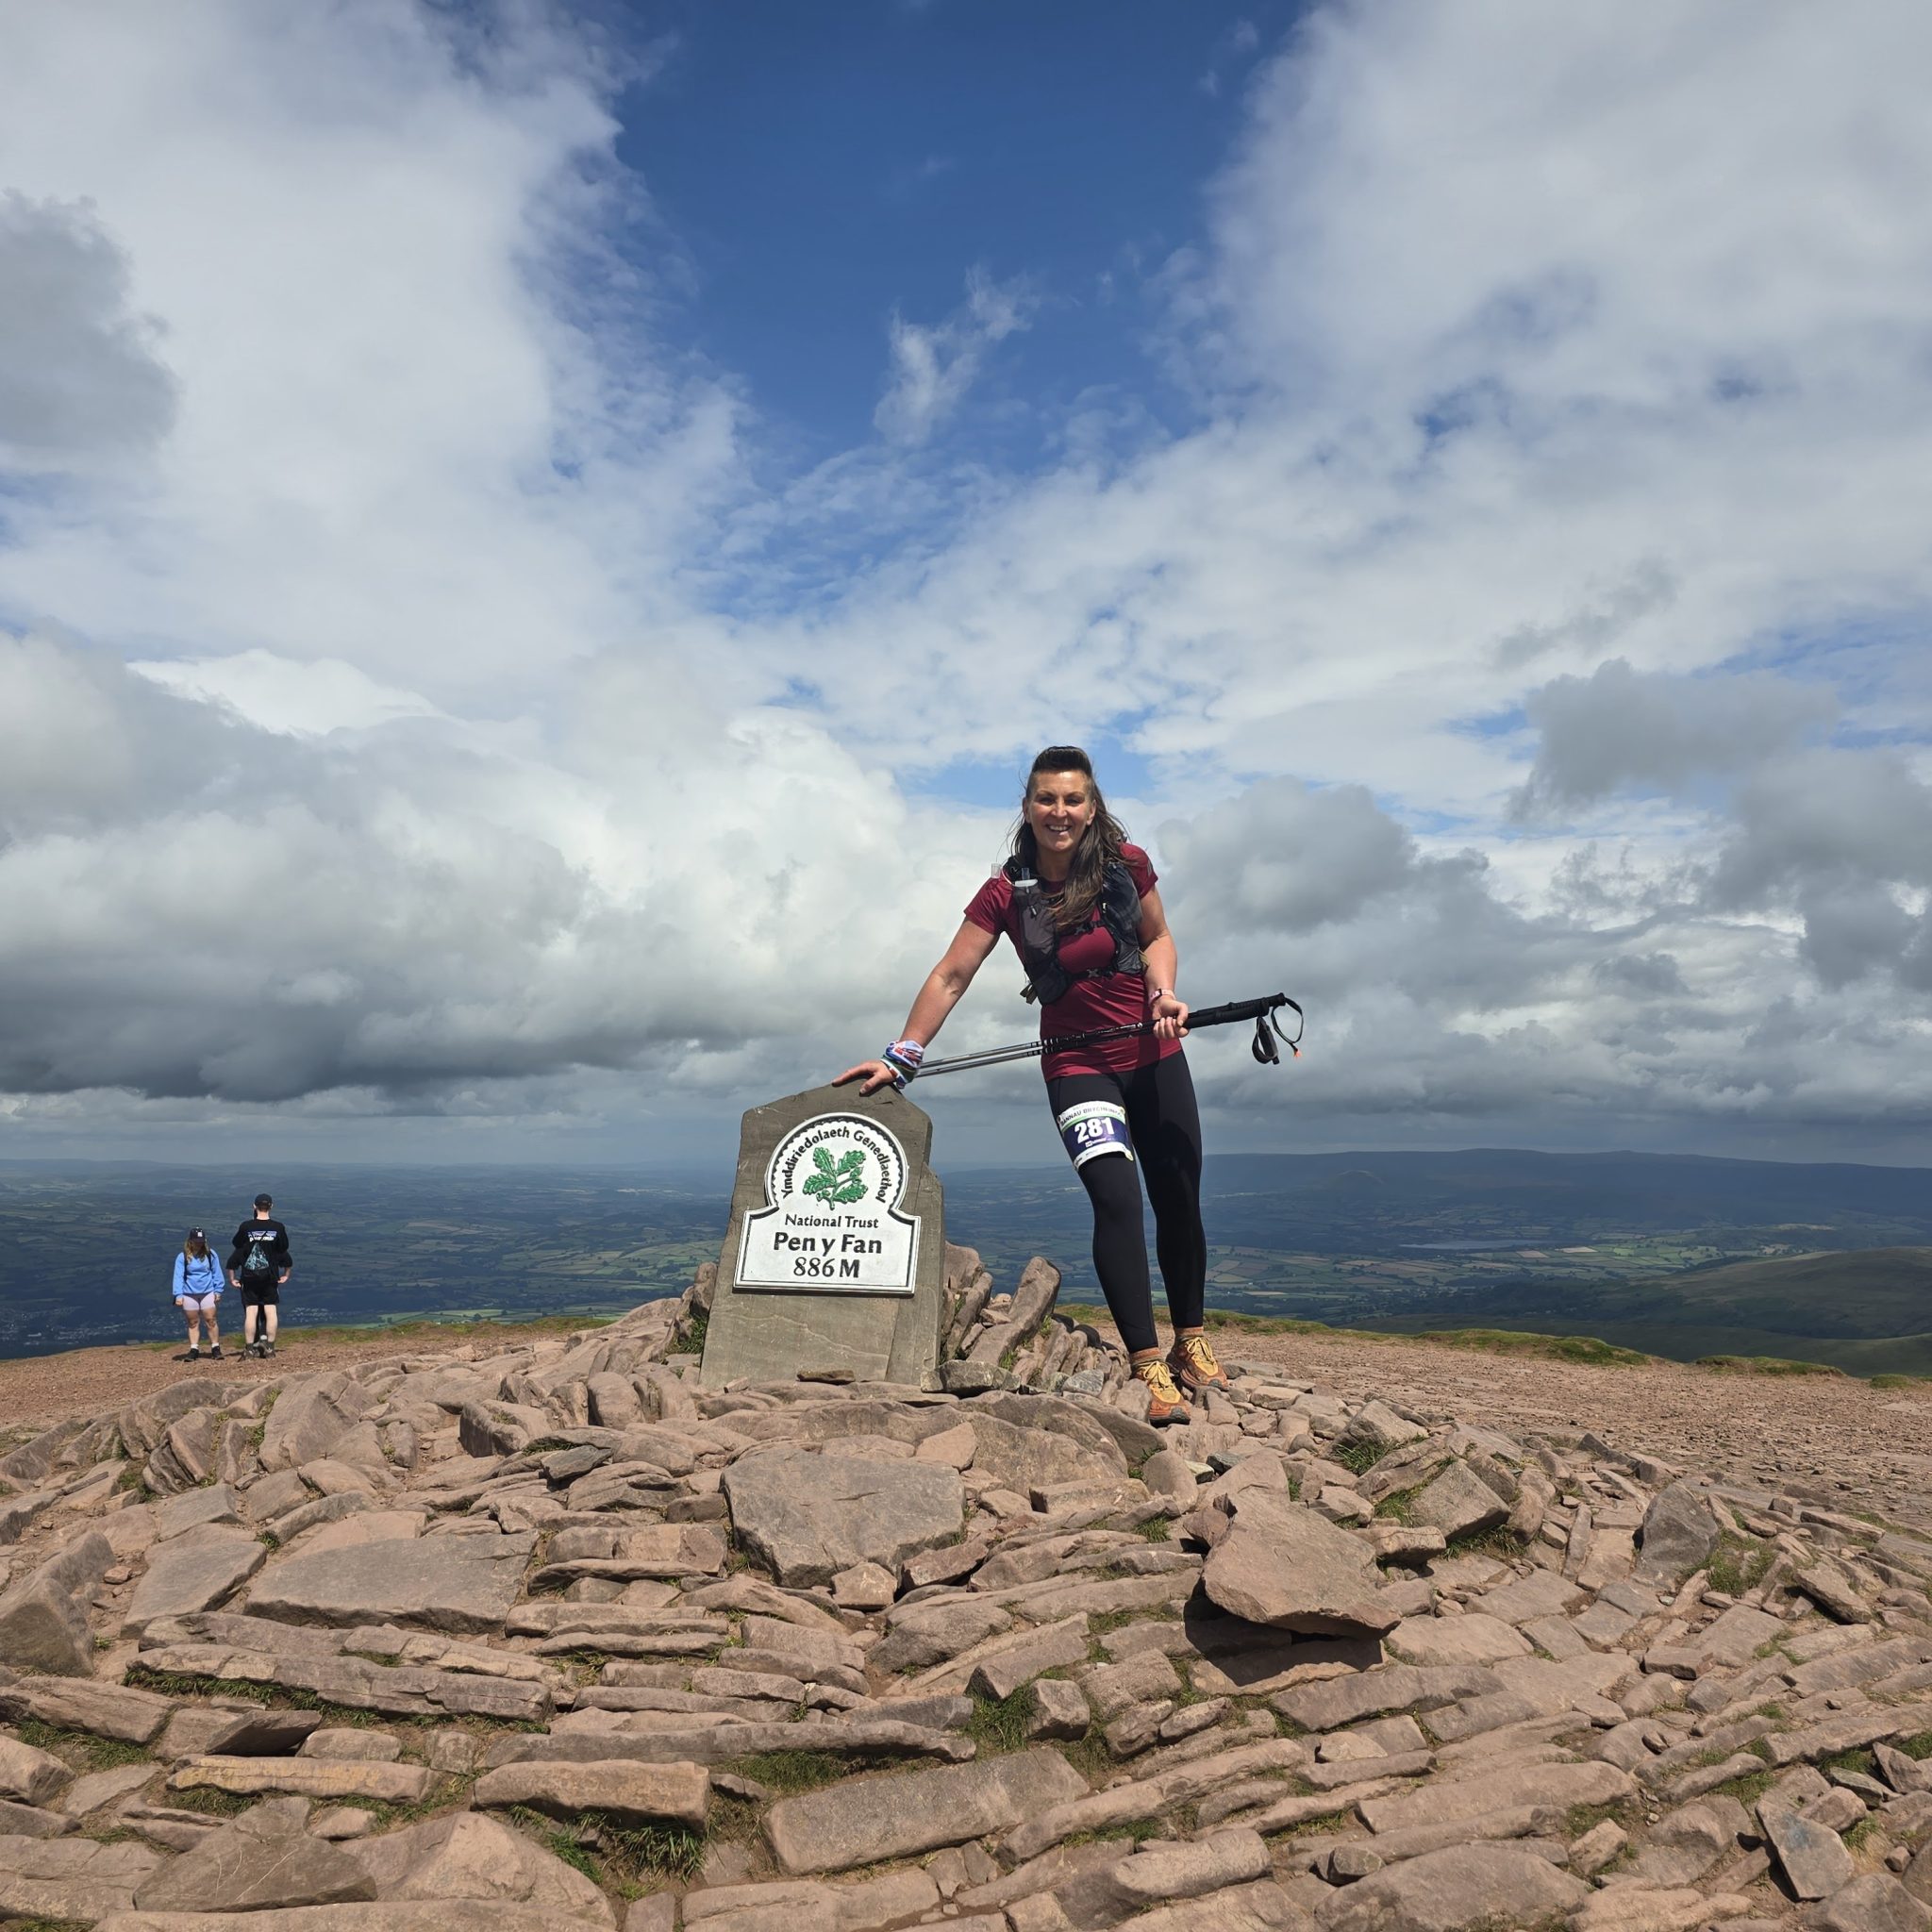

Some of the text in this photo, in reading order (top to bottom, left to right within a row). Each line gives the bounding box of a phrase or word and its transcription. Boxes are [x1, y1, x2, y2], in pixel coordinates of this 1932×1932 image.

[1074, 1117, 1114, 1143] 281
[781, 1126, 892, 1203] Ymddiriedolaeth Genedlaethol
[785, 1214, 878, 1228] National Trust
[774, 1232, 882, 1257] Pen y Fan
[793, 1257, 860, 1278] 886 M
